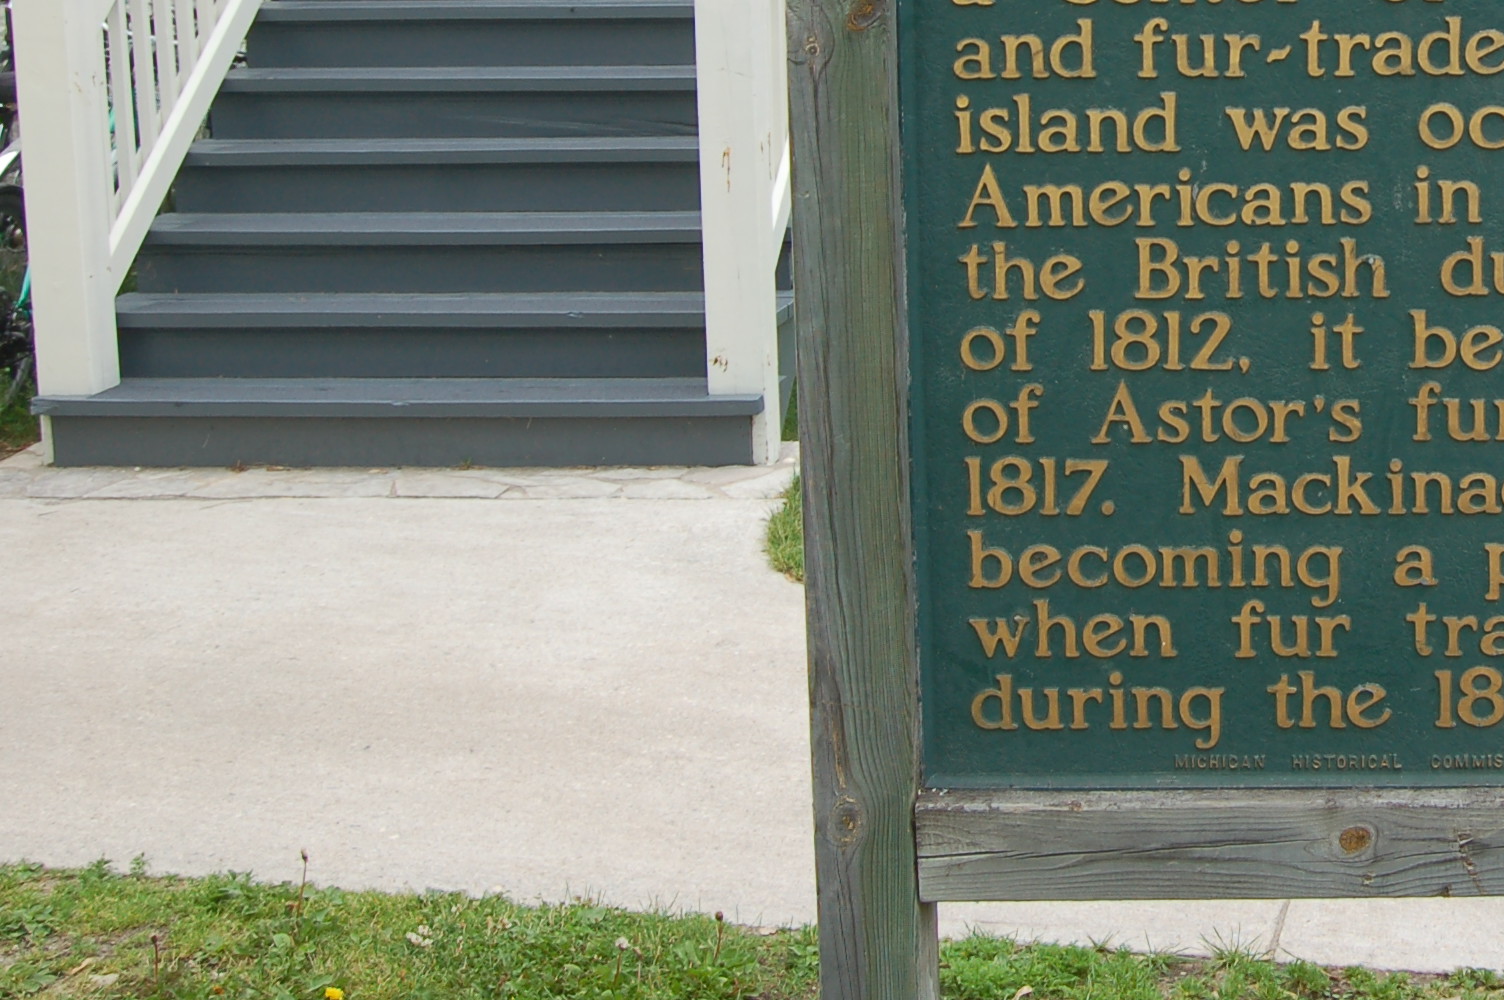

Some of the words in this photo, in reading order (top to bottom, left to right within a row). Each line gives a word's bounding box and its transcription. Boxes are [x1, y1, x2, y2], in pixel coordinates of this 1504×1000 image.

[953, 18, 1096, 80] and
[954, 92, 1180, 154] island
[1224, 107, 1370, 151] was
[958, 164, 1373, 228] Americans
[1414, 166, 1482, 224] in
[959, 241, 1085, 300] the
[1134, 237, 1390, 300] British
[959, 310, 1041, 371] of
[1088, 310, 1251, 374] 1812,
[1310, 313, 1363, 370] it
[962, 384, 1044, 444] of
[1091, 381, 1363, 444] Astor's
[964, 457, 1115, 516] 1817.
[967, 530, 1343, 608] becoming
[1393, 546, 1438, 587] a
[969, 599, 1177, 658] when
[1231, 600, 1351, 658] fur
[971, 672, 1225, 749] during
[1267, 671, 1392, 729] the
[1172, 753, 1266, 770] MICHIGAN
[1292, 752, 1402, 770] HISTORICAL
